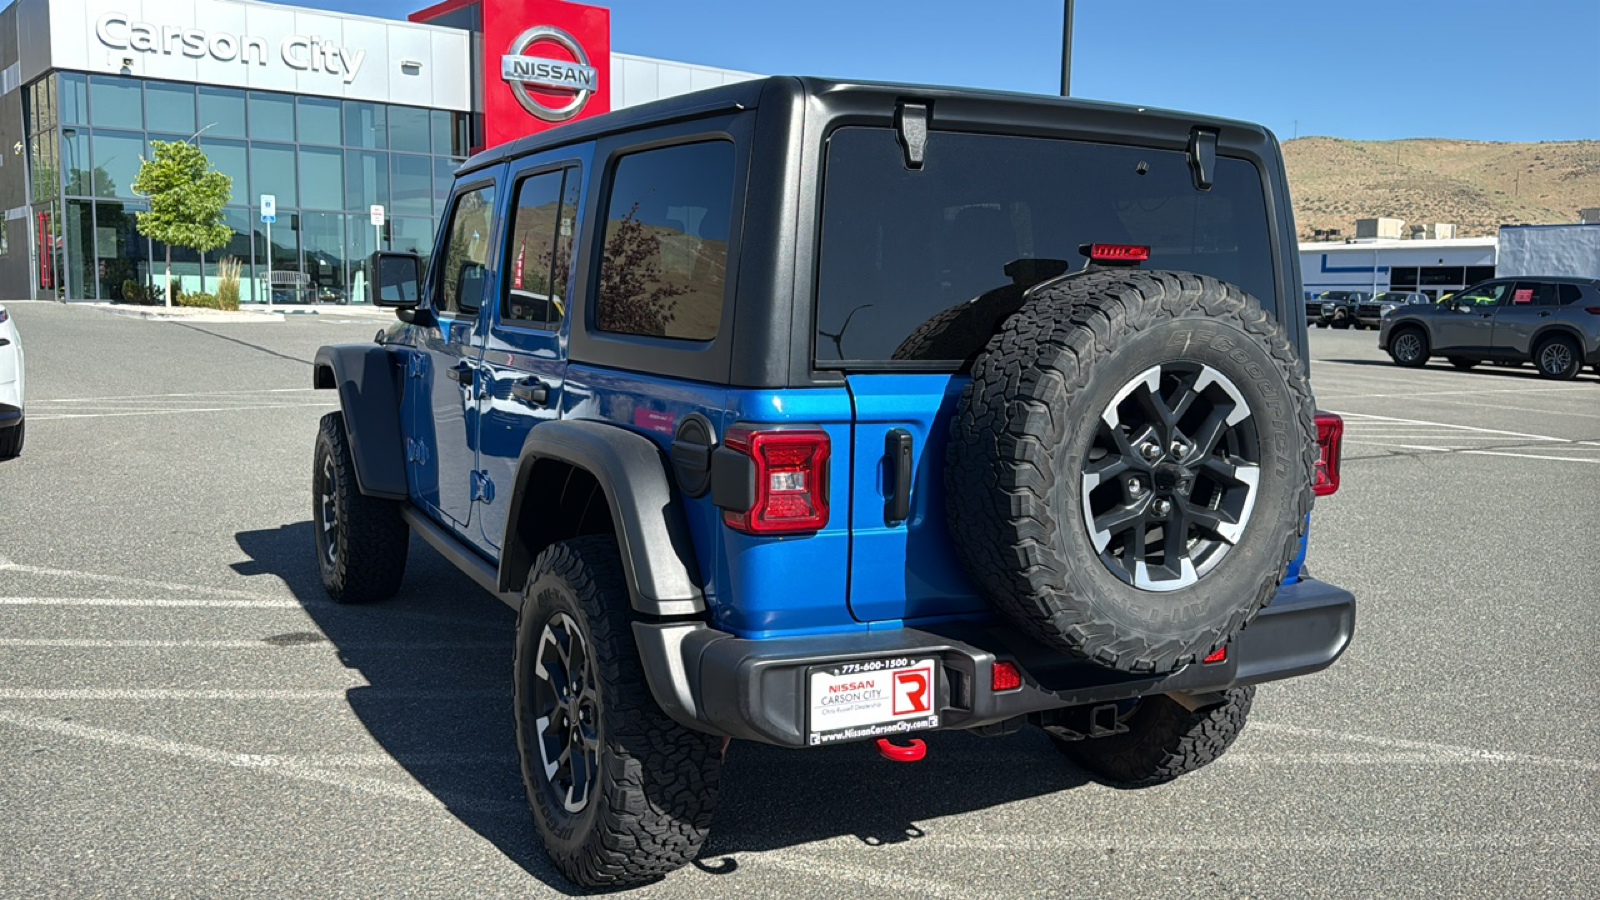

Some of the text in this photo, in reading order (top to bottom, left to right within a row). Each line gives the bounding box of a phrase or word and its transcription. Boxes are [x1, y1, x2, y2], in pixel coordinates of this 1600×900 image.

[95, 11, 366, 85] Carson City
[513, 60, 590, 86] NISSAN
[842, 658, 908, 673] 775-600-1500
[828, 679, 875, 693] NISSAN
[820, 689, 882, 706] CARSON CITY
[820, 720, 928, 742] www.NissanCarsonCity.com
